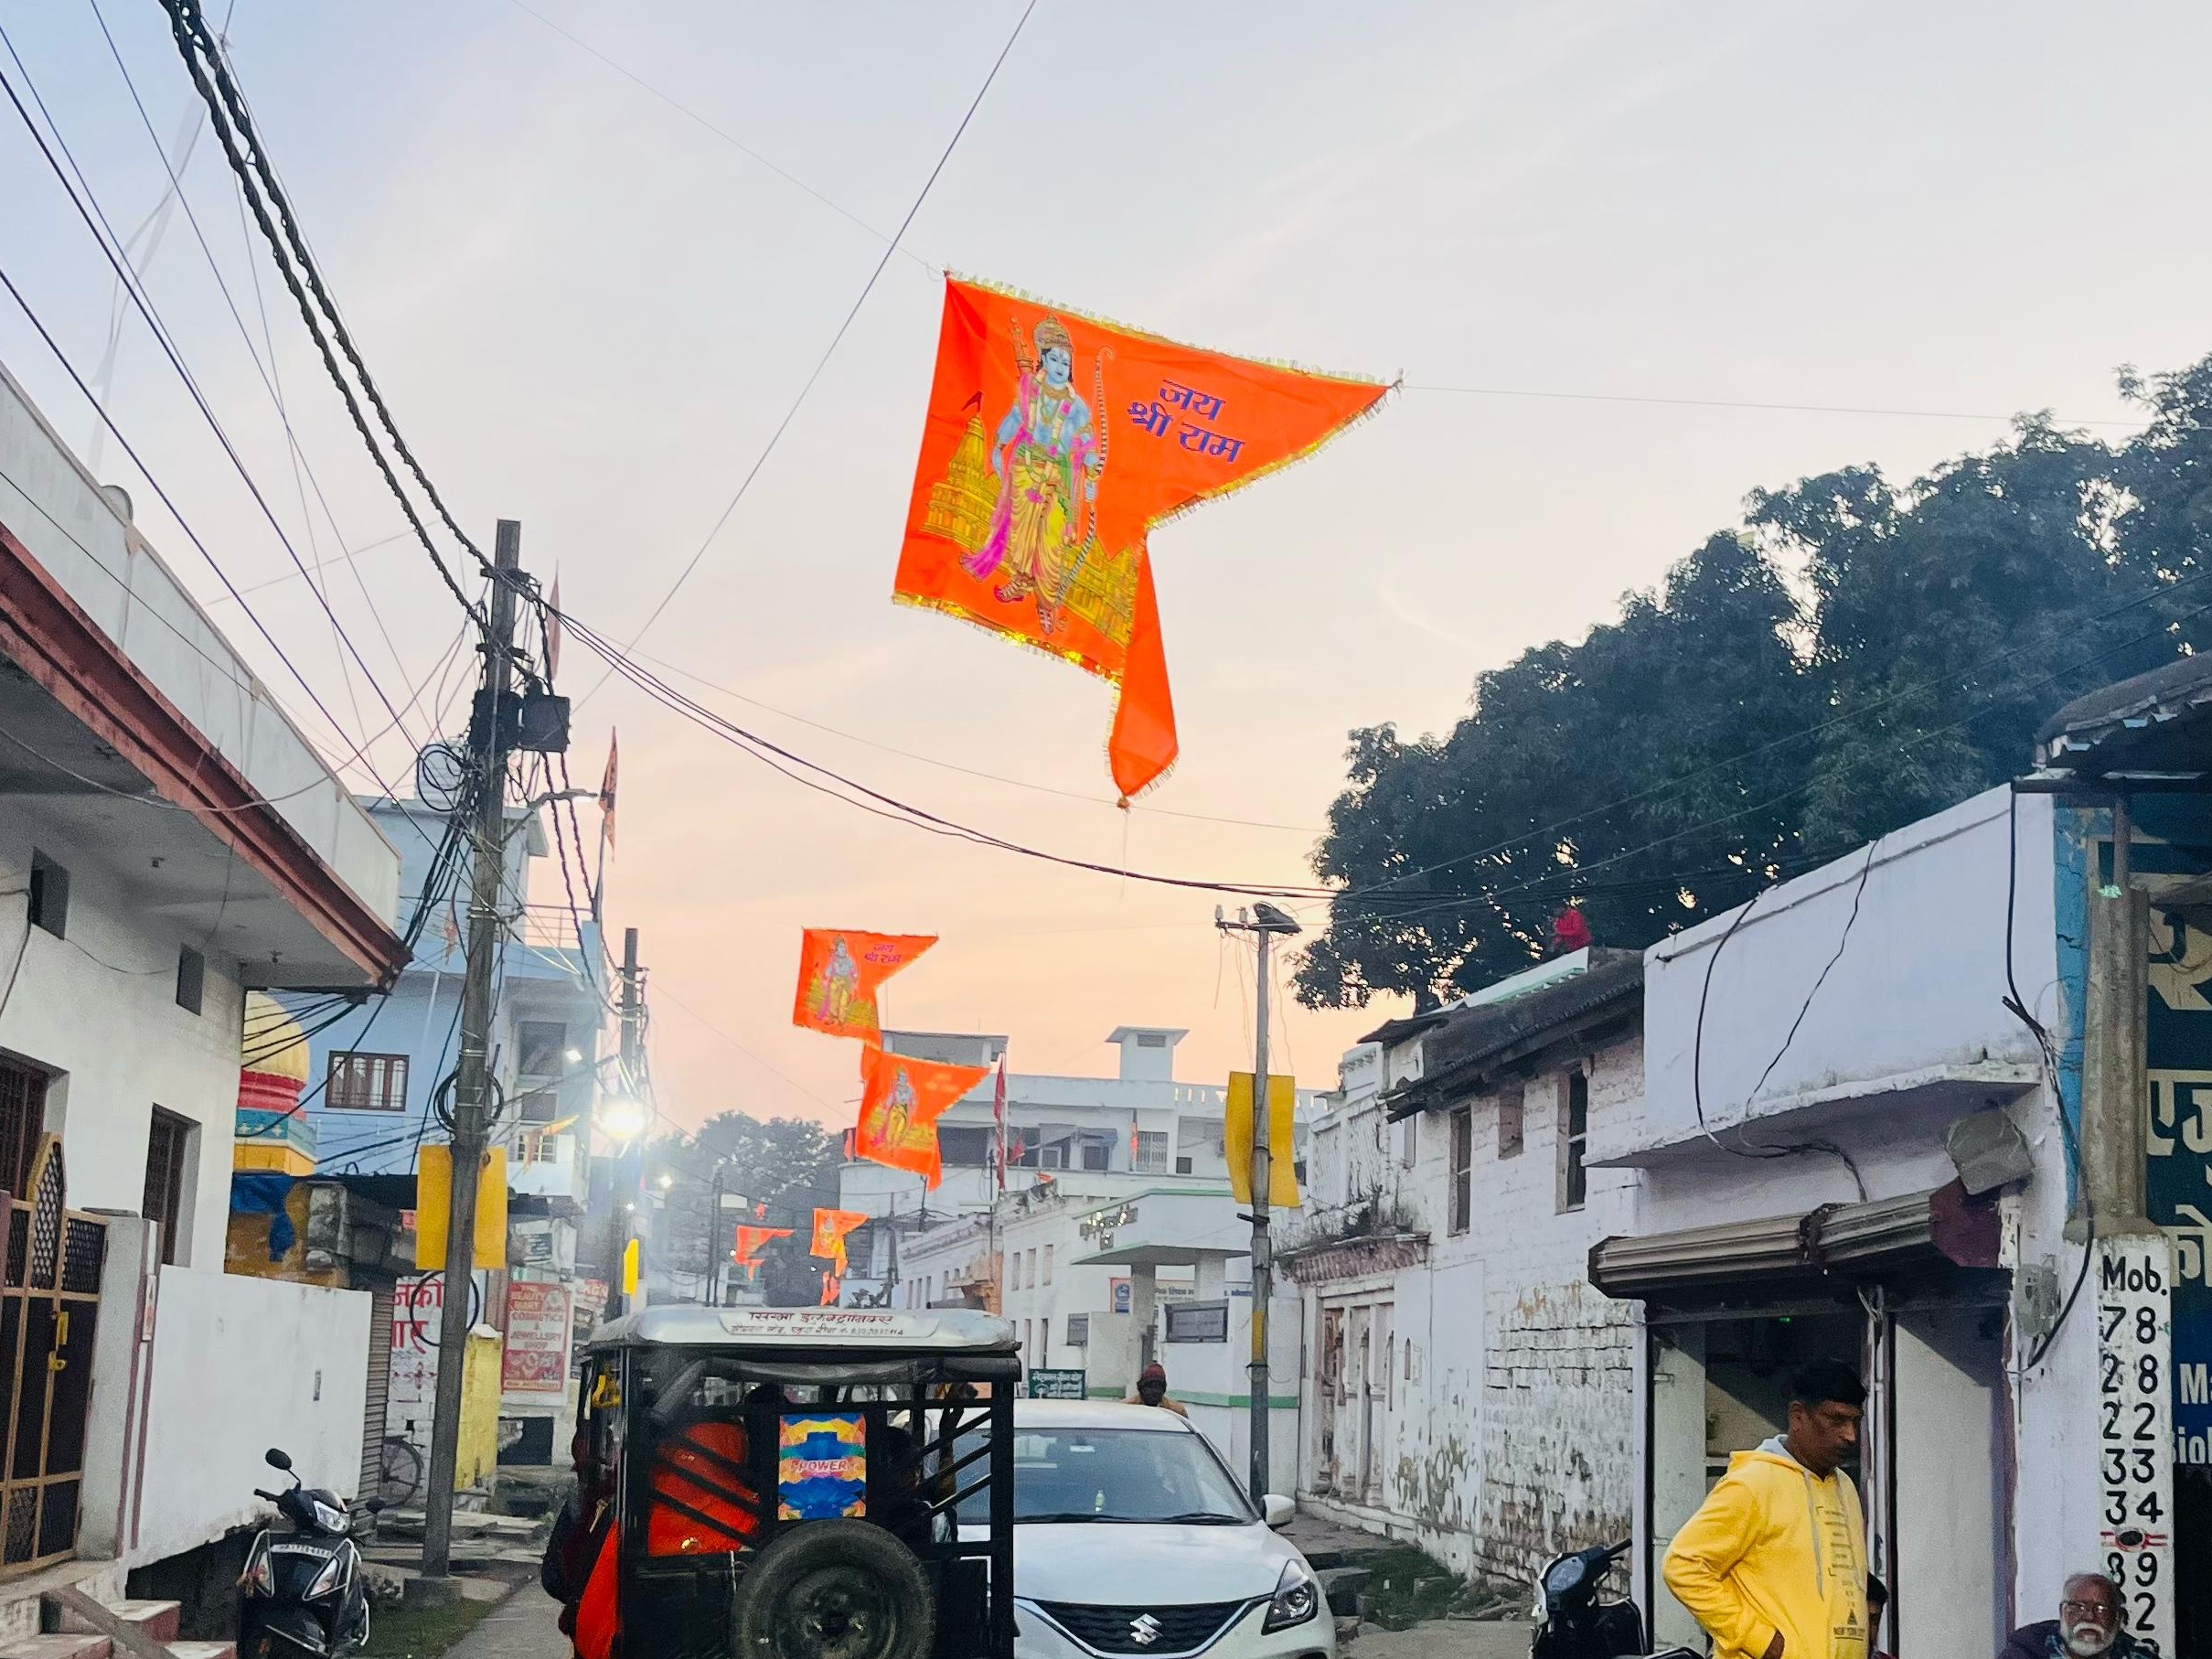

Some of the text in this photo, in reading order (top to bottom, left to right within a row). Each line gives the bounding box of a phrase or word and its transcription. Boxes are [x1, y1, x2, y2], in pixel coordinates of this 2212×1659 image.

[1159, 379, 1226, 421] जय
[1127, 401, 1245, 463] श्री राम
[2103, 1255, 2168, 1296] Mob.
[2179, 1363, 2212, 1404] M
